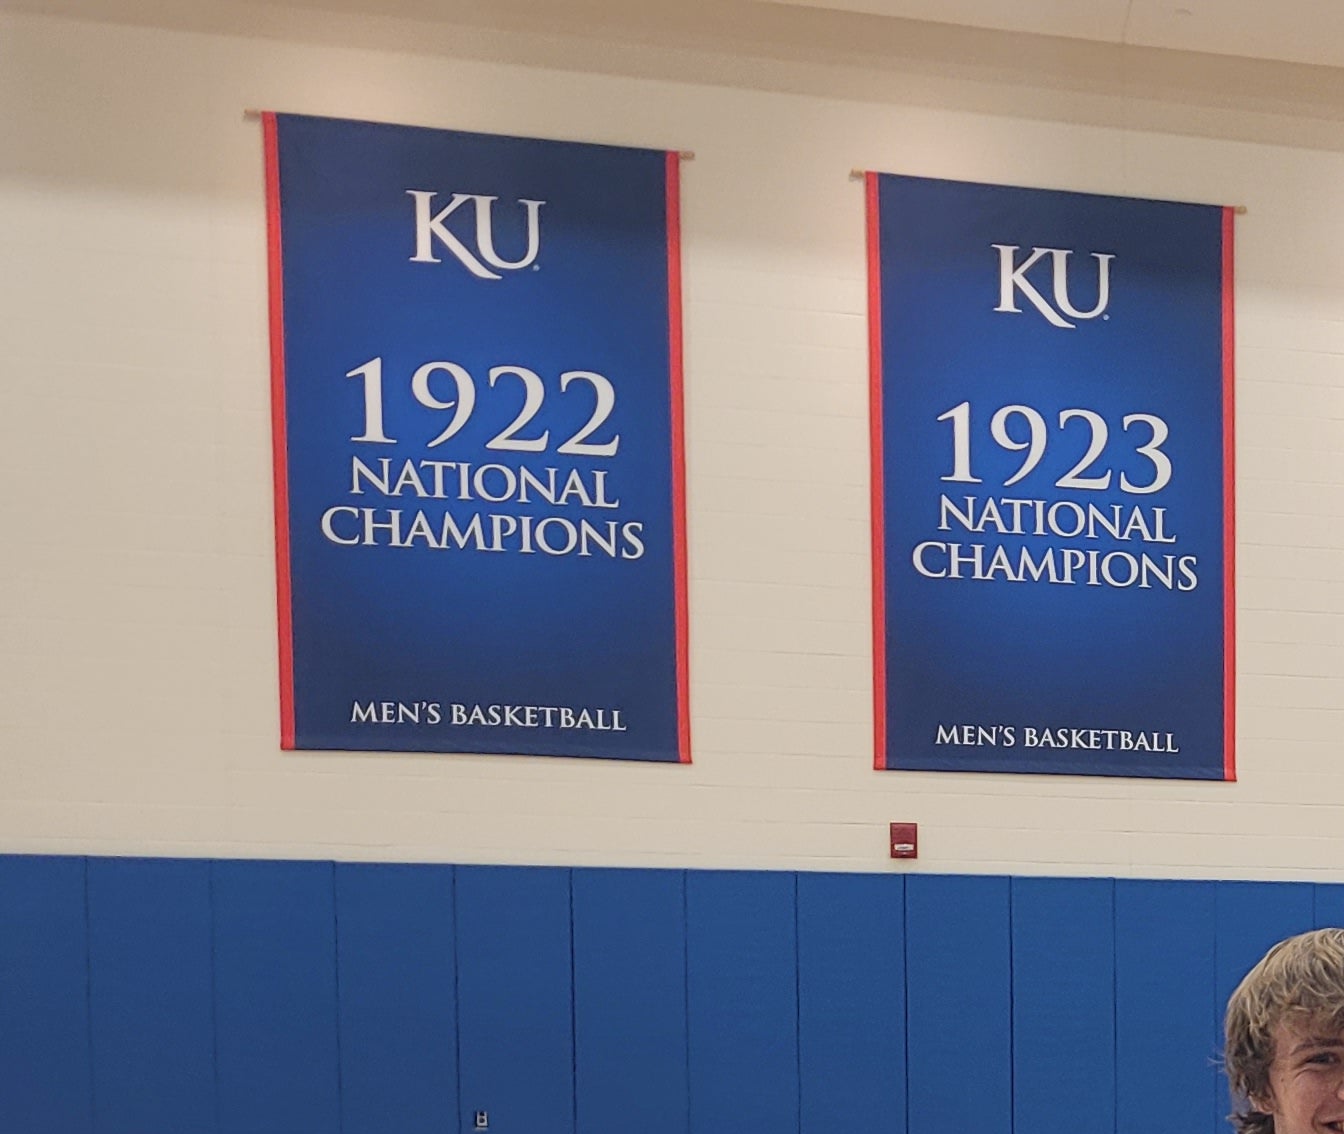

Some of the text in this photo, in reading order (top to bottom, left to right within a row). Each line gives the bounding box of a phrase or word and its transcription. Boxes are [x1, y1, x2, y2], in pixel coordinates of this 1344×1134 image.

[406, 190, 546, 280] KU
[991, 244, 1115, 329] KU
[345, 357, 620, 457] 1922
[937, 401, 1172, 494] 1923
[350, 456, 619, 508] NATIONAL
[320, 505, 645, 560] CHAMPIONS
[938, 494, 1177, 544] NATIONAL
[912, 540, 1199, 591] CHAMPIONS
[351, 701, 627, 731] MEN'S BASKETBALL
[935, 724, 1179, 753] MEN'S BASKETBALL
